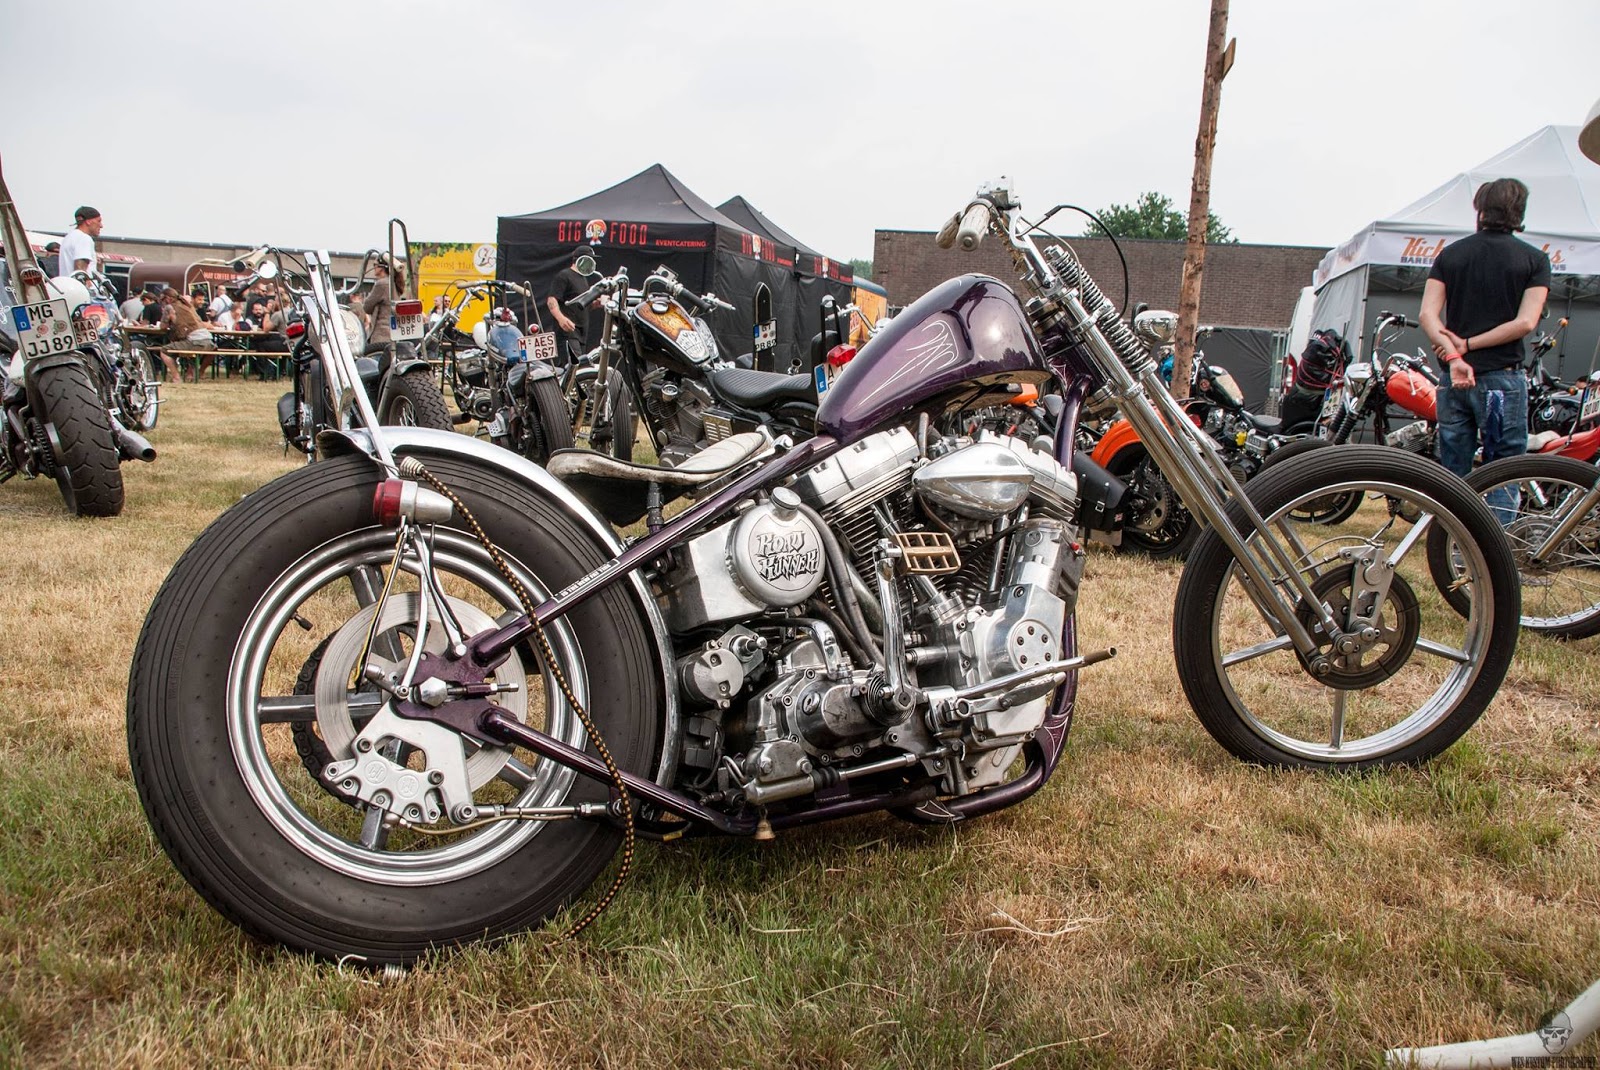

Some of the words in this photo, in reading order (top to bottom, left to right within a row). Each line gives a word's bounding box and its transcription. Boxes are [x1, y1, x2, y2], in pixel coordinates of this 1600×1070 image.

[558, 221, 581, 242] BIG
[610, 222, 647, 245] FOOD
[655, 239, 706, 248] EVENTCATERING
[28, 304, 53, 321] MG
[535, 346, 554, 359] 667
[756, 531, 806, 556] ROAD
[758, 549, 819, 582] RUNNER
